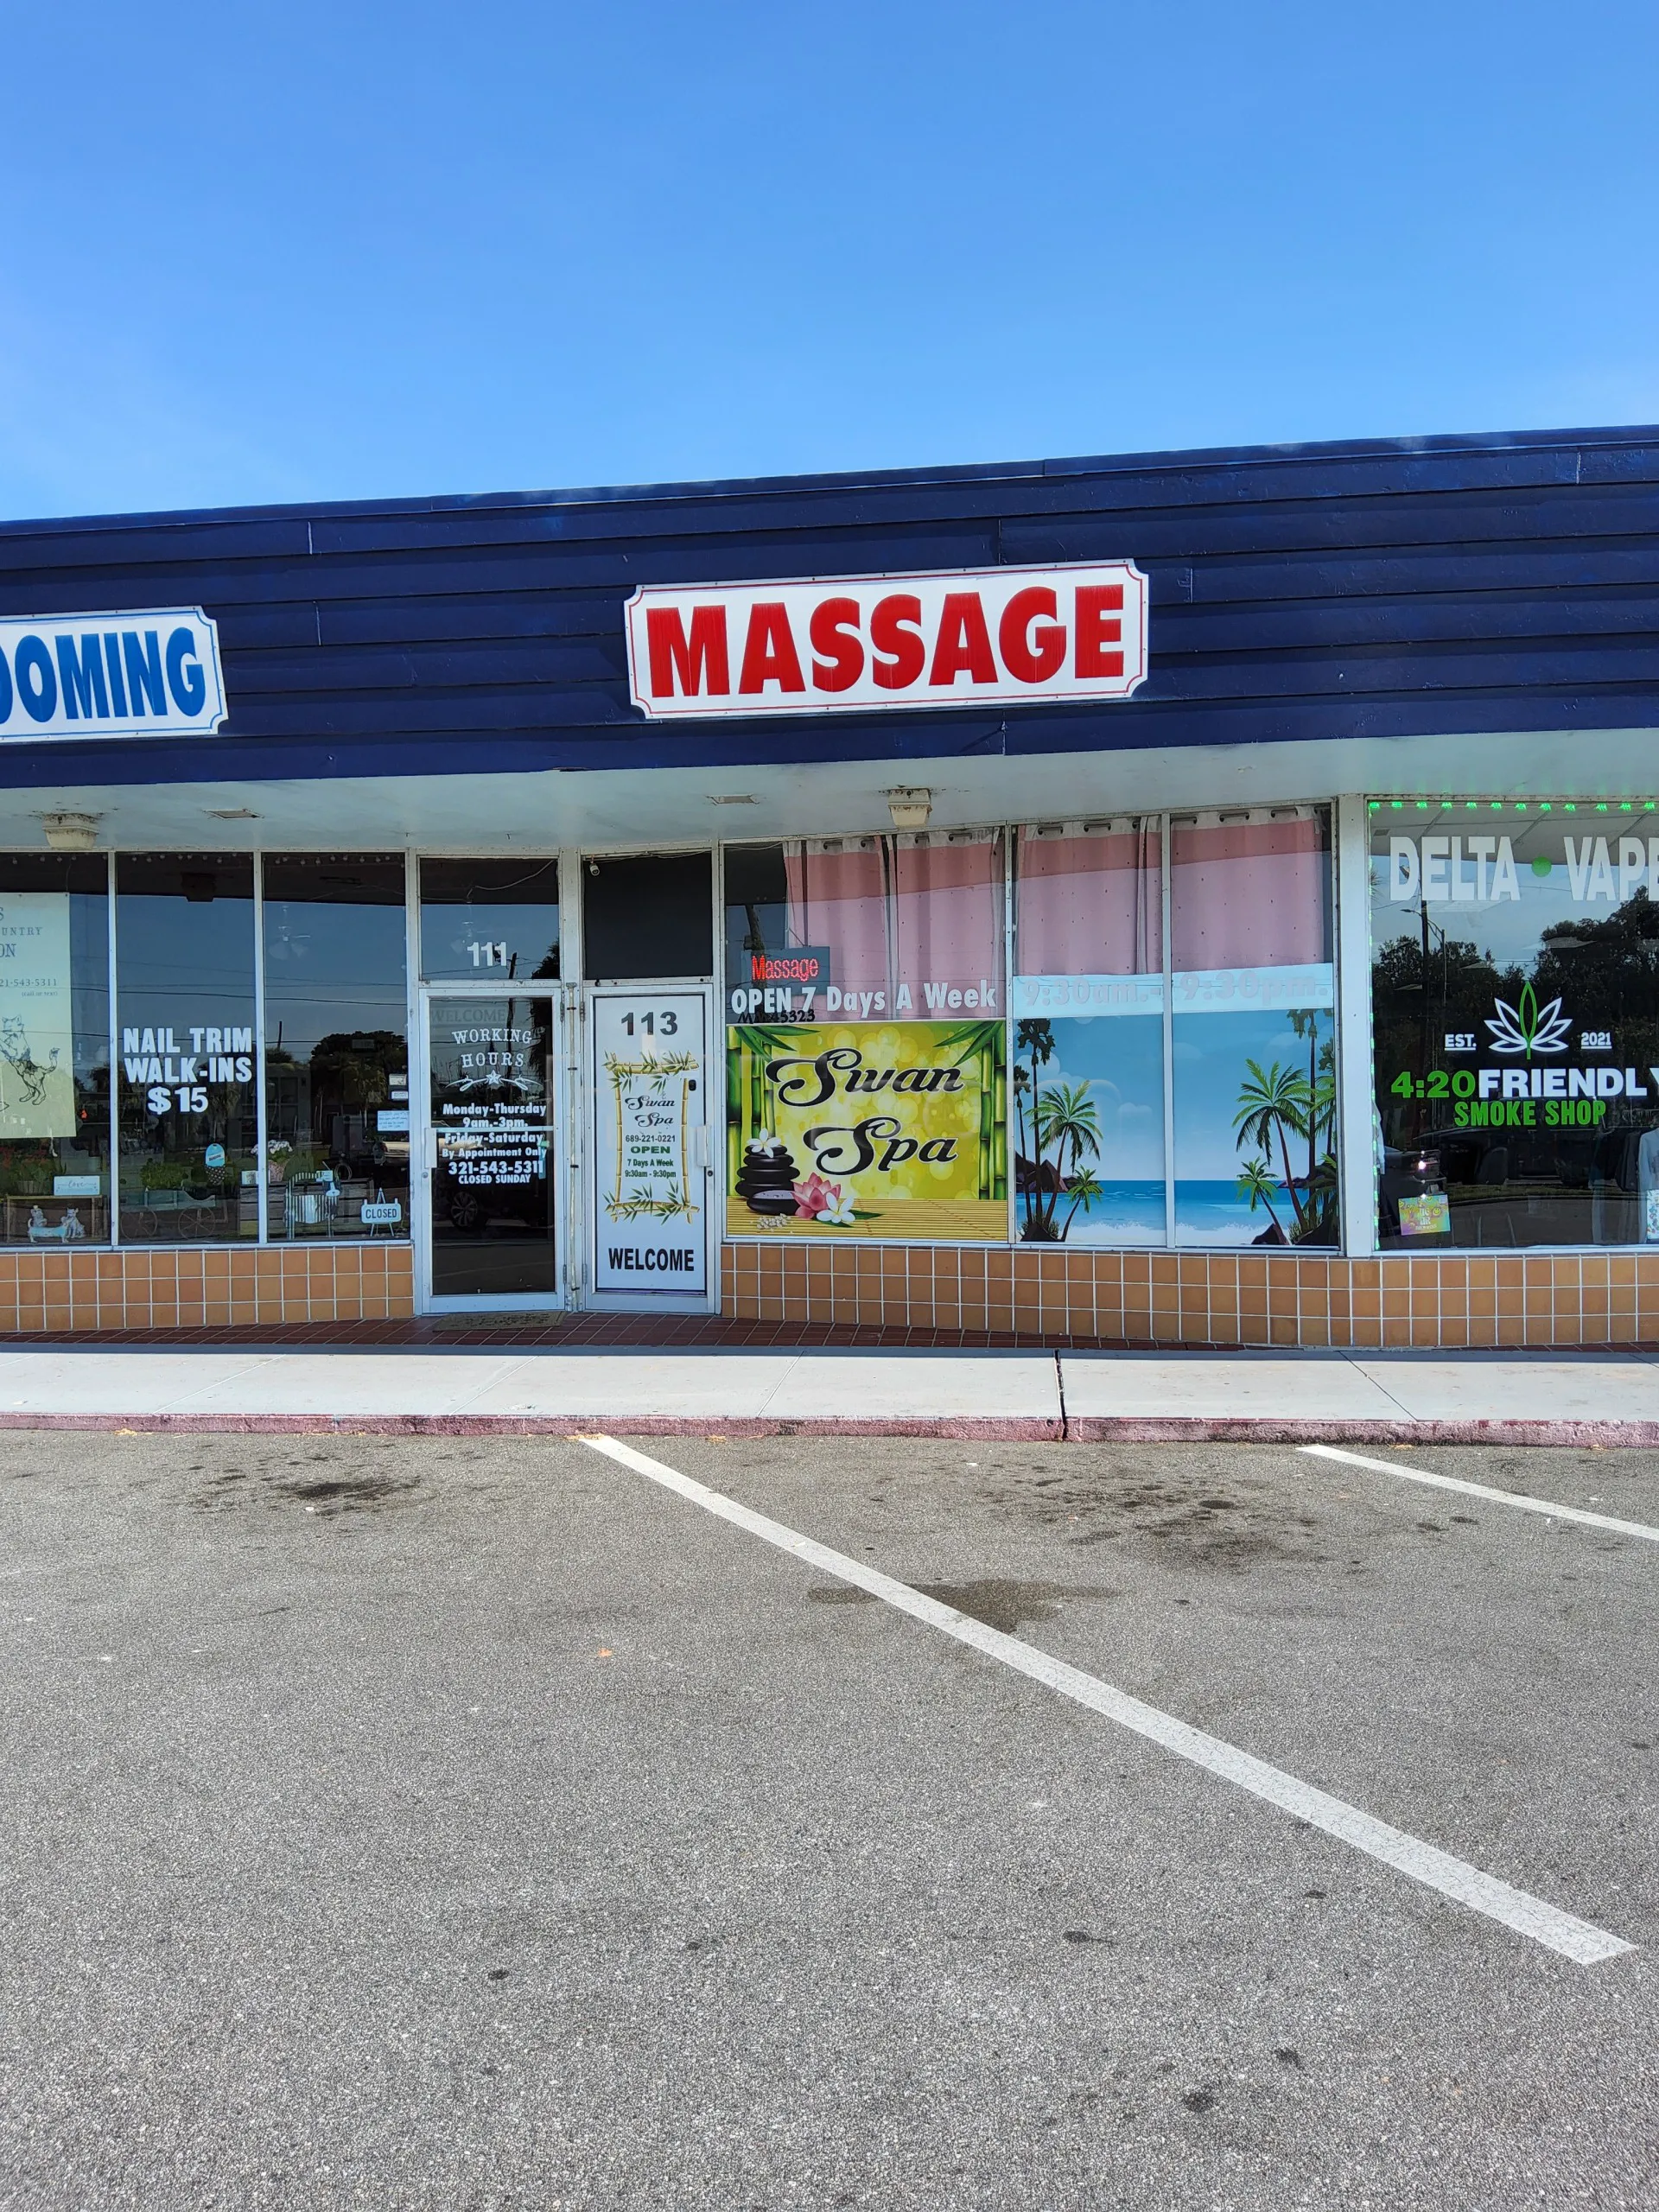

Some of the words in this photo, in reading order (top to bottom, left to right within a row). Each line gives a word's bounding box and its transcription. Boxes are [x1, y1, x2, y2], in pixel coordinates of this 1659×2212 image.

[646, 584, 1124, 698] MASSAGE
[1389, 836, 1521, 901] DELTA
[467, 941, 507, 967] 111
[751, 955, 819, 982] Massage
[731, 987, 791, 1014] OPEN
[802, 986, 817, 1013] 7
[827, 984, 885, 1020] Days
[896, 983, 913, 1010] A
[924, 979, 996, 1009] Week
[432, 1008, 506, 1023] WELCOME
[621, 1011, 678, 1036] 113
[124, 1027, 181, 1053] NAIL
[189, 1027, 252, 1053] TRIM
[451, 1028, 532, 1045] WORKING
[1444, 1033, 1477, 1049] EST.
[1580, 1032, 1612, 1047] 2021
[461, 1052, 524, 1068] HOURS
[124, 1056, 253, 1084] WALK-INS
[765, 1047, 965, 1107] Swan
[147, 1085, 209, 1116] $15
[625, 1095, 677, 1110] Swan
[442, 1103, 547, 1117] Monday-Thursday
[1454, 1100, 1537, 1127] SMOKE
[1545, 1099, 1607, 1125] SHOP
[634, 1112, 674, 1128] Spa
[444, 1131, 544, 1147] Friday-Saturday
[803, 1116, 960, 1176] Spa
[442, 1148, 454, 1160] By
[458, 1147, 522, 1160] Appointment
[524, 1147, 547, 1158] Only
[448, 1160, 544, 1175] 321-543-5311
[633, 1159, 649, 1168] Days
[458, 1174, 493, 1185] CLOSED
[495, 1173, 531, 1184] SUNDAY
[653, 1170, 677, 1179] 9:30pm
[365, 1209, 397, 1219] CLOSED
[608, 1247, 695, 1272] WELCOME
